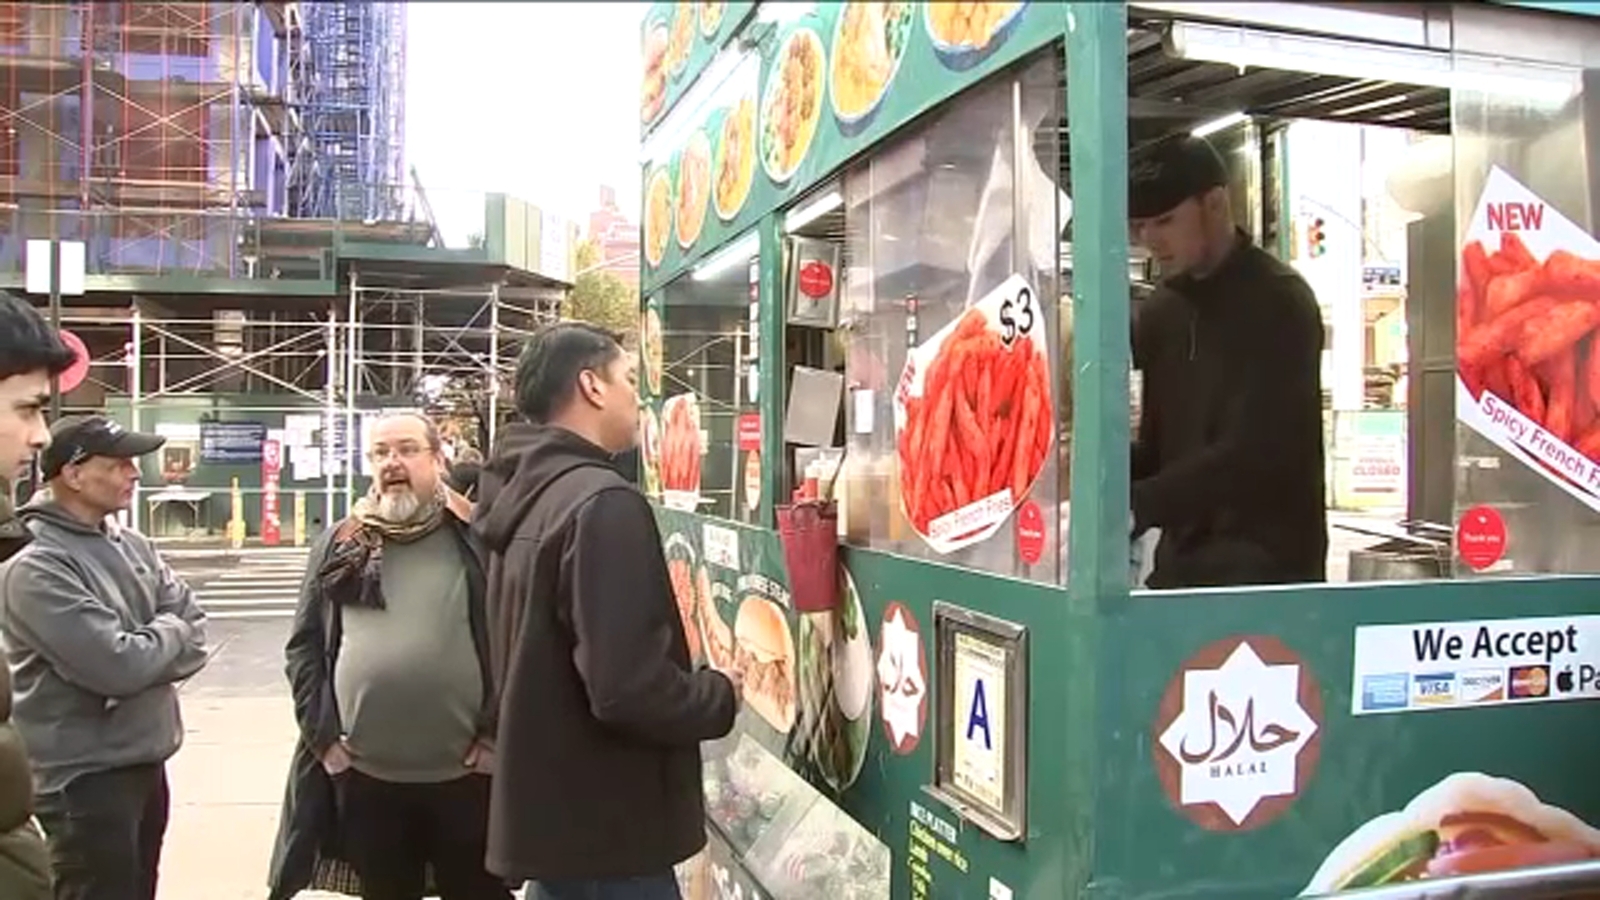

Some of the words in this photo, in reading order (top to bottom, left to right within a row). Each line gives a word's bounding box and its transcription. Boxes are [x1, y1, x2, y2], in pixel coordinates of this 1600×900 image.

[1487, 202, 1544, 231] NEW
[1000, 287, 1034, 345] $3
[1481, 397, 1529, 441] Spicy
[1530, 429, 1585, 477] French
[1413, 626, 1463, 661] We
[1471, 624, 1578, 662] Accept
[1420, 682, 1450, 695] VISA
[966, 678, 992, 750] A
[1180, 689, 1301, 764] حلال
[1210, 761, 1268, 778] HALAL
